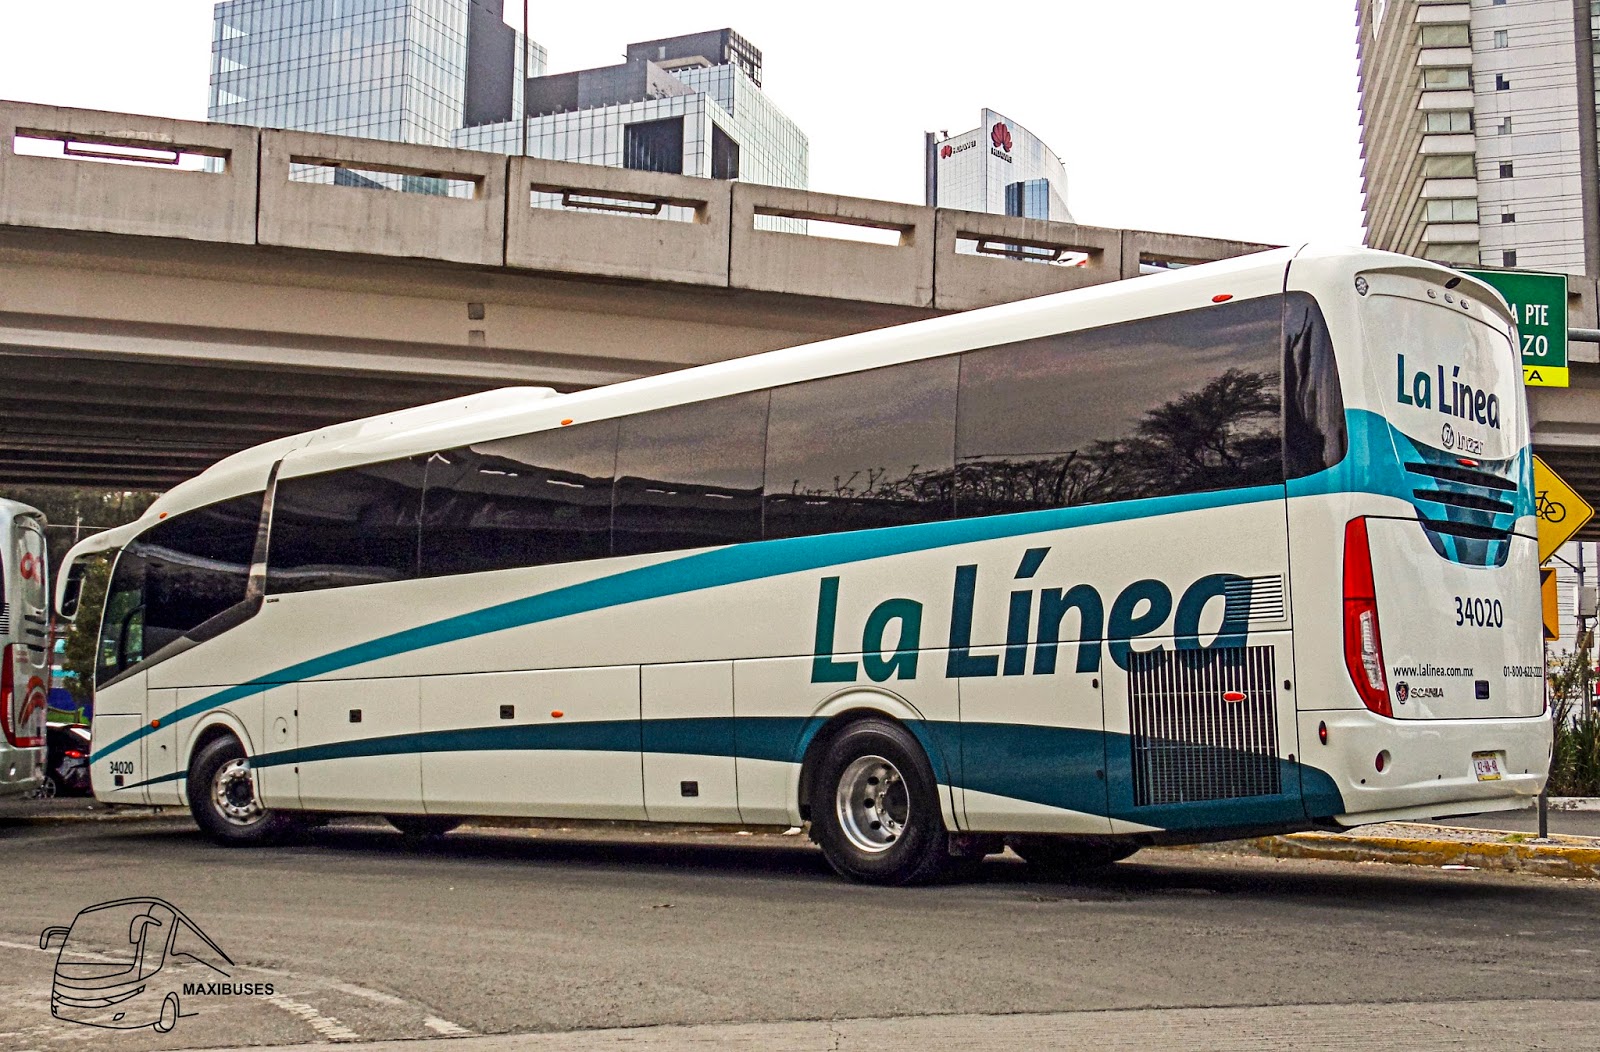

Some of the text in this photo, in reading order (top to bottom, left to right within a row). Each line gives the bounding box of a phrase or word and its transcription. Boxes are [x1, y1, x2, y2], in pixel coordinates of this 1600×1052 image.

[1525, 304, 1549, 326] PTE
[1397, 353, 1501, 430] La Línea
[811, 546, 1252, 683] La Línea
[1454, 596, 1503, 628] 34020
[1392, 663, 1474, 677] www.lalinea.com.mx
[1410, 687, 1444, 699] SCANIA
[109, 761, 134, 775] 34020
